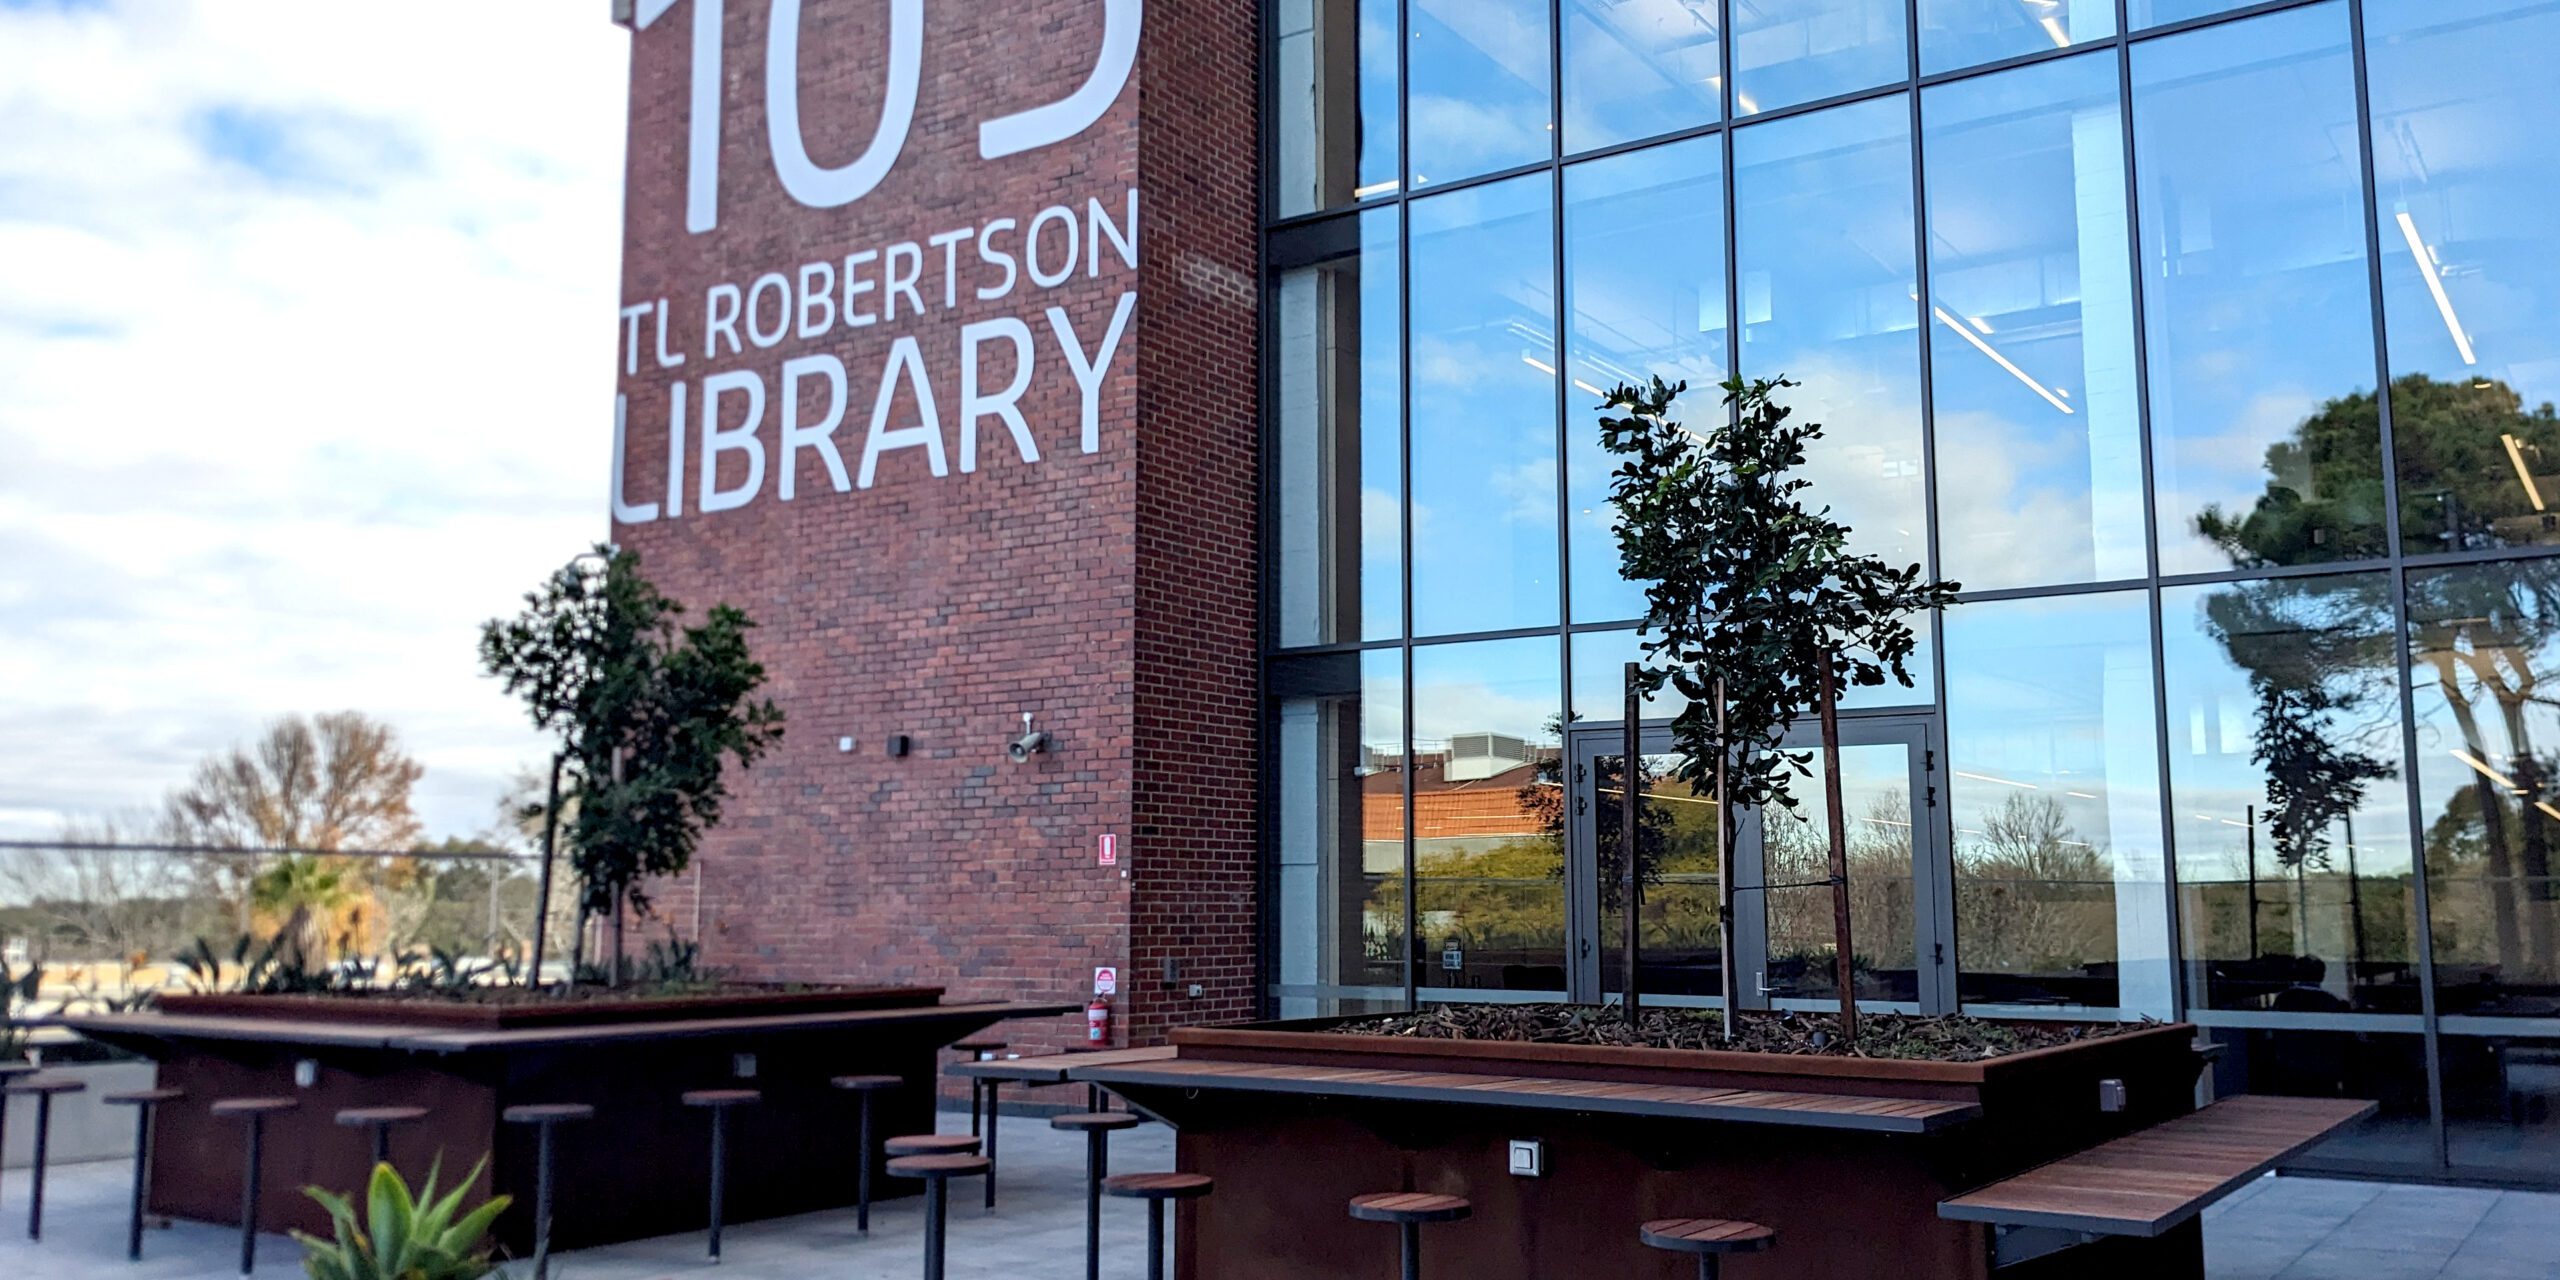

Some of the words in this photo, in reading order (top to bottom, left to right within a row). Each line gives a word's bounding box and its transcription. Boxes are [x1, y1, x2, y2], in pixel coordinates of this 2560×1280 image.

[620, 298, 686, 376] TL
[704, 188, 1138, 359] ROBERTSON
[611, 291, 1138, 524] LIBRARY
